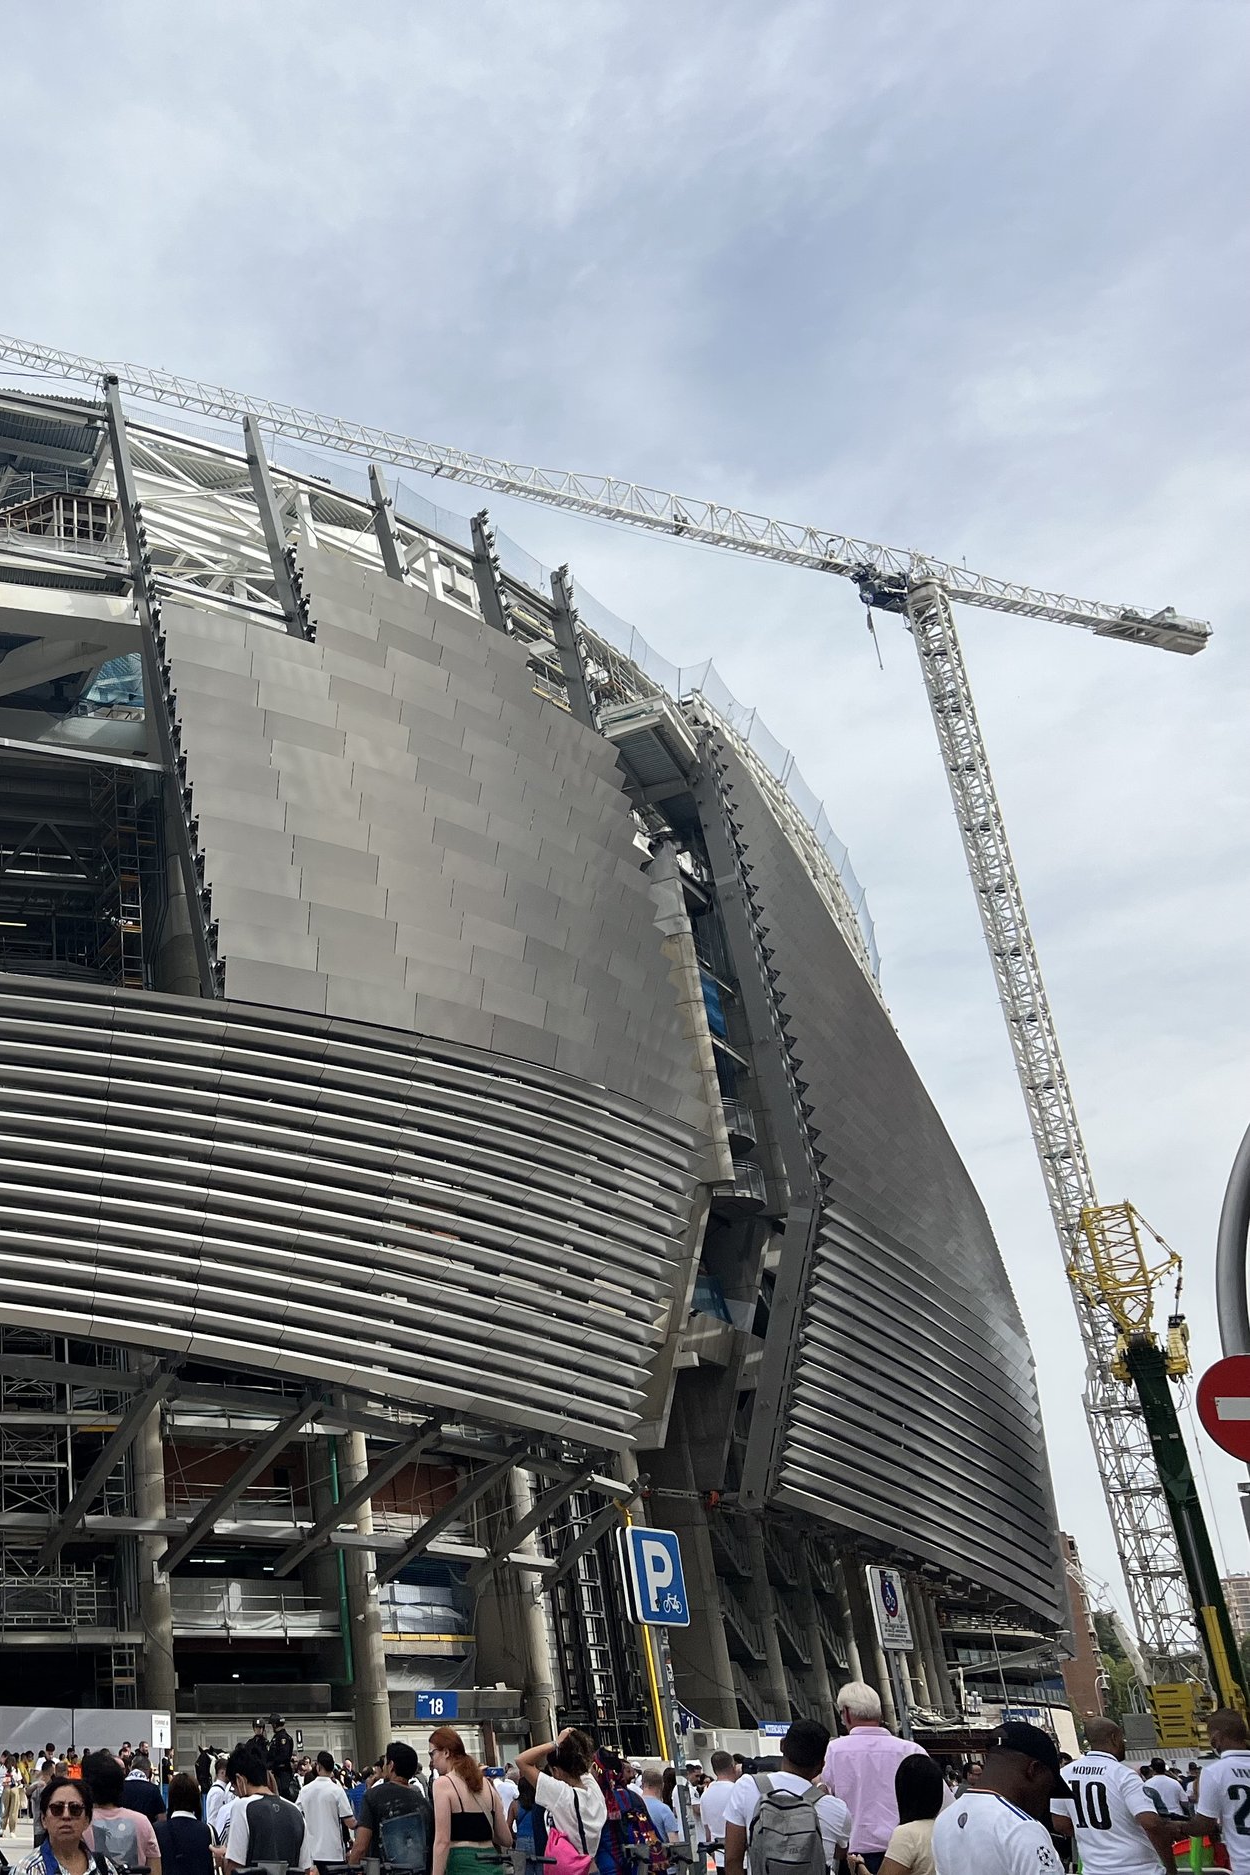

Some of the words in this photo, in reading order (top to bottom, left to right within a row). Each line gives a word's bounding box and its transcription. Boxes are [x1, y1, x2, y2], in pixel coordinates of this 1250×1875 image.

[641, 1539, 673, 1612] P
[429, 1698, 444, 1715] 18
[1068, 1780, 1112, 1830] 10
